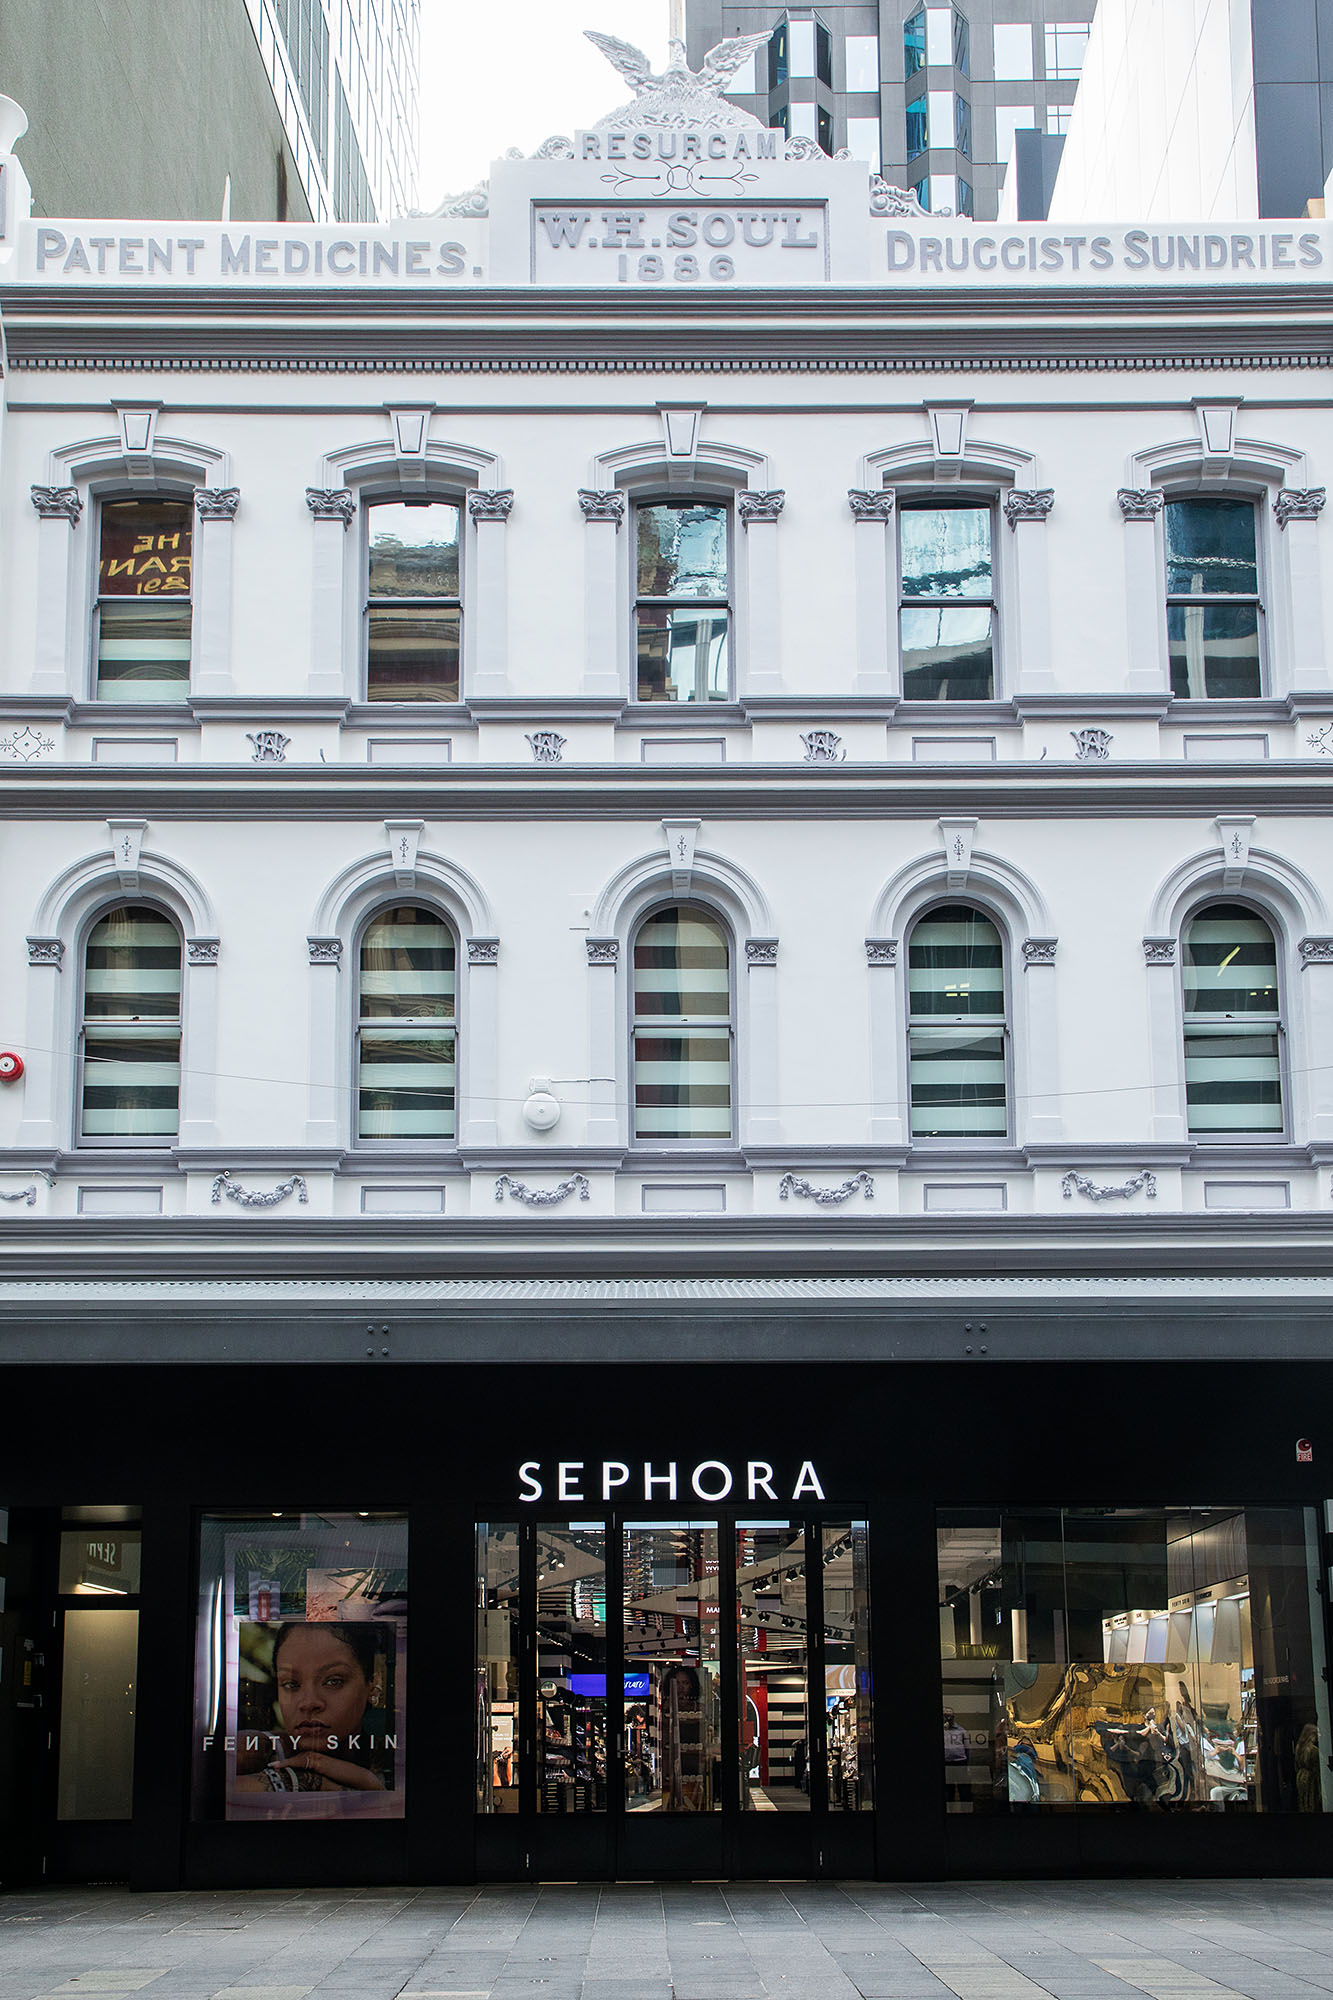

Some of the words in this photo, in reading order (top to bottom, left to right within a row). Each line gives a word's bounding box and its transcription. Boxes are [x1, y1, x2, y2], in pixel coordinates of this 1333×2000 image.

[36, 228, 205, 275] PATENT
[220, 232, 483, 276] MEDICINES.
[618, 253, 735, 282] 1886
[886, 229, 1114, 272] DRUGGISTS
[1123, 229, 1324, 271] SUNDRIES
[1297, 1452, 1313, 1462] FIRE
[518, 1460, 826, 1502] SEPHORA
[326, 1734, 398, 1750] SKIN
